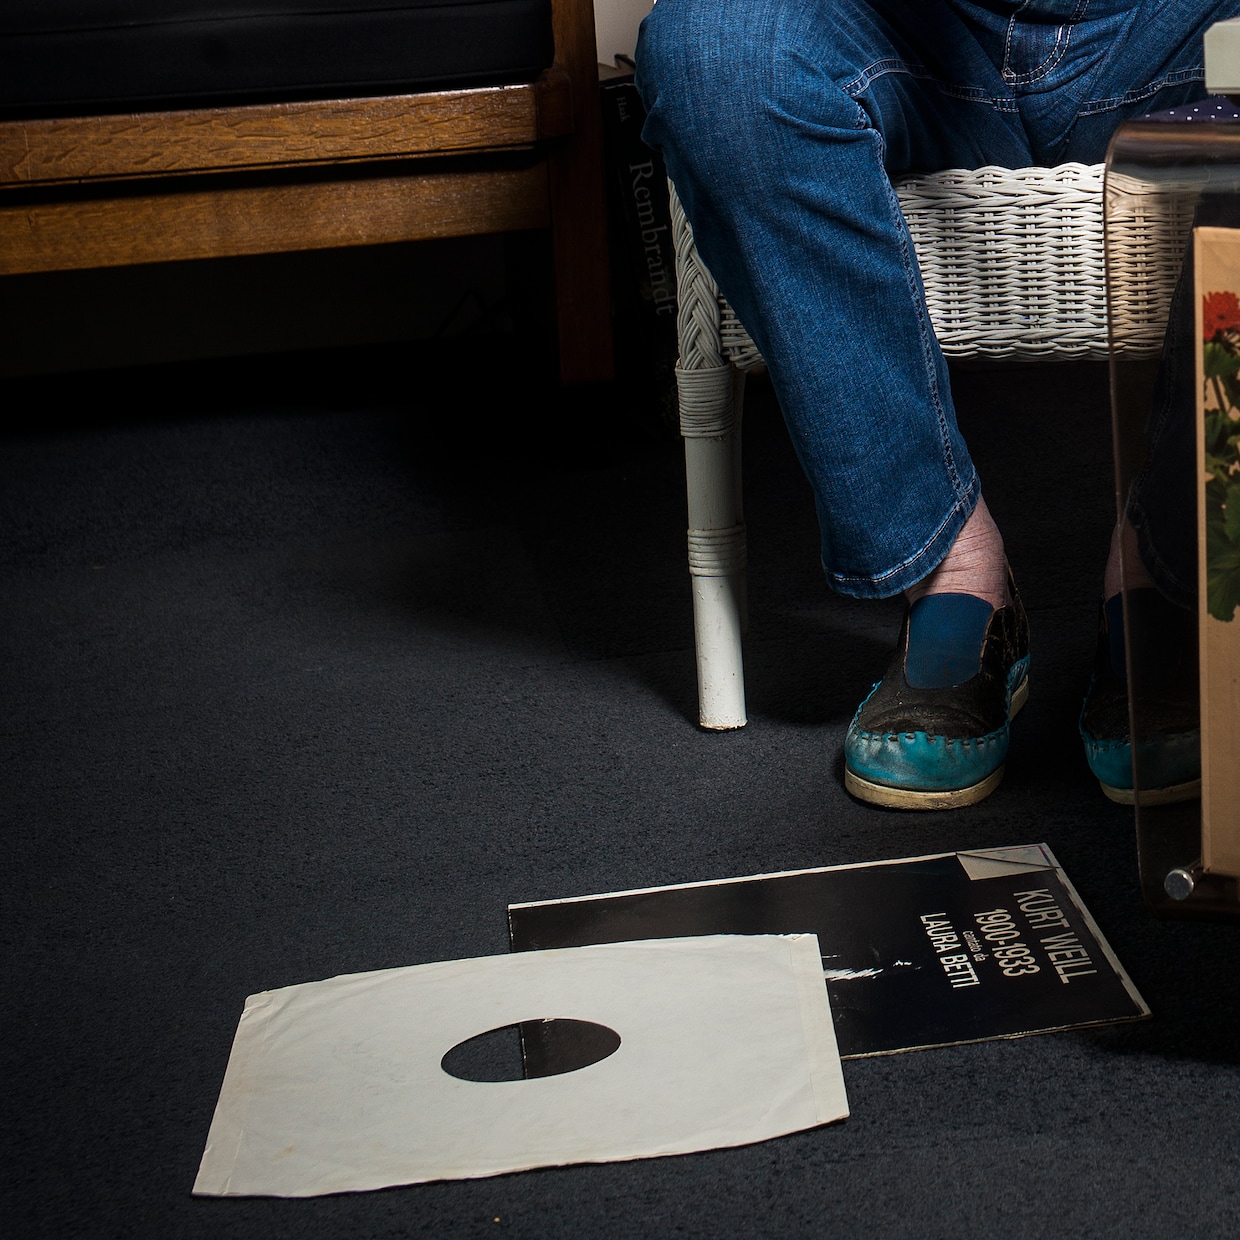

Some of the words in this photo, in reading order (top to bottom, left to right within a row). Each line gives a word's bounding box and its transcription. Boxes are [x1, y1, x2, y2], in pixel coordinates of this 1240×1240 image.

[629, 161, 677, 316] Rembrandt
[1013, 888, 1071, 930] KURT
[919, 912, 962, 954] LAURA
[973, 908, 1041, 978] 1900-1933
[939, 953, 981, 989] BETTI
[973, 953, 990, 962] da
[1040, 931, 1098, 985] WEILL
